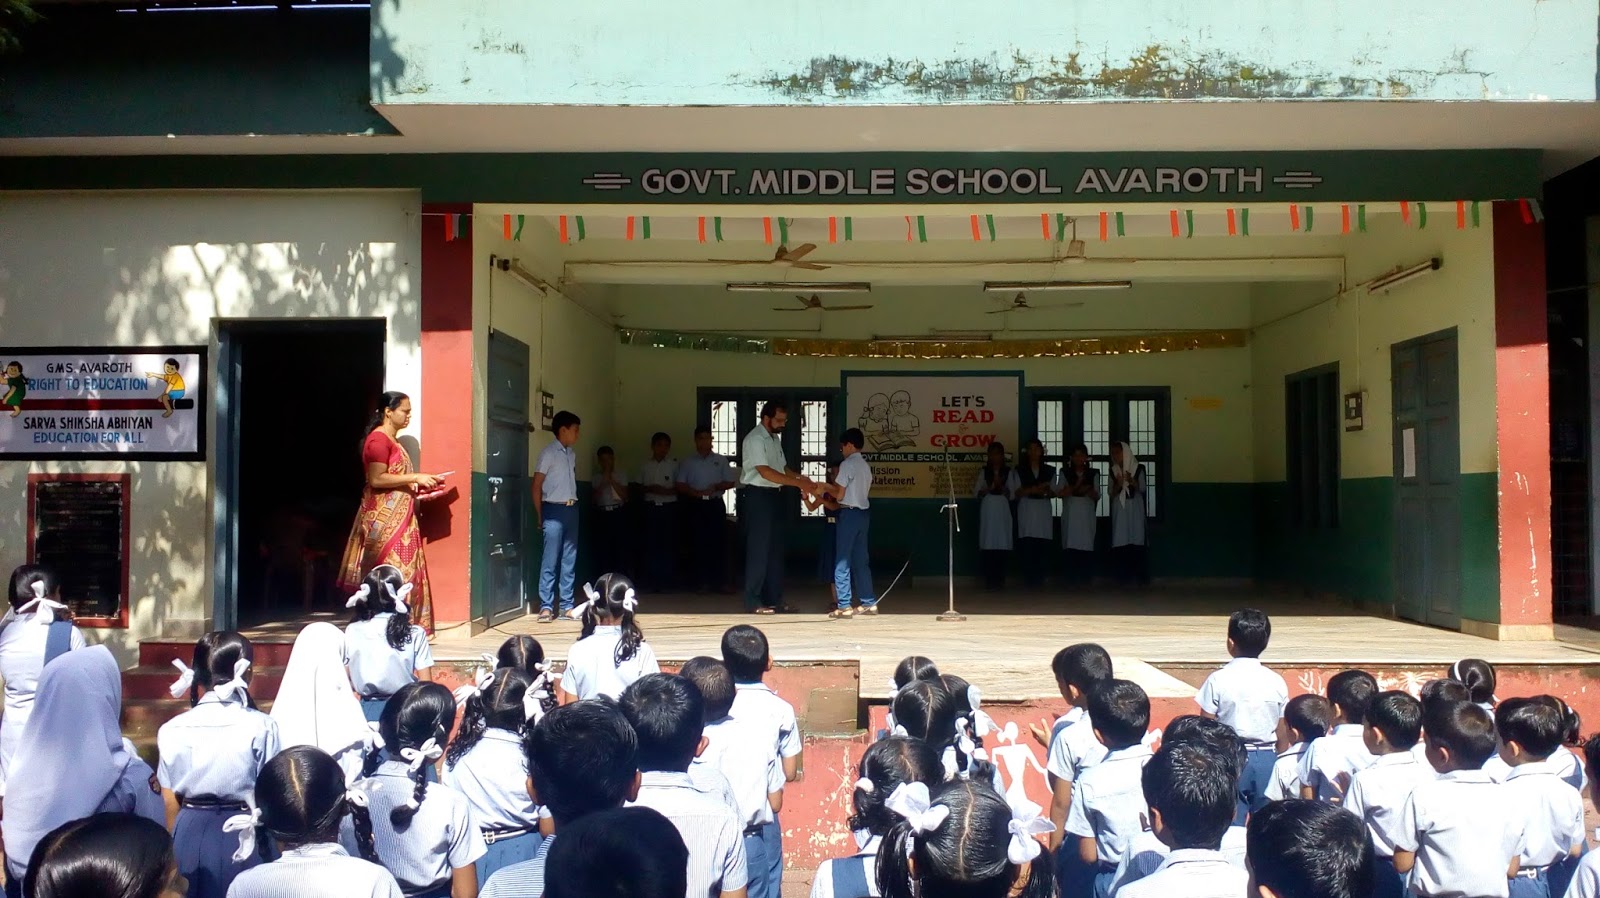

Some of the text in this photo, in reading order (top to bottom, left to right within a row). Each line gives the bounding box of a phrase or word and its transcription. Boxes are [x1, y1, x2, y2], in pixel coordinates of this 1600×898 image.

[640, 167, 1264, 195] GOVT. MIDDLE SCHOOL AVAROTH
[79, 362, 133, 373] AVAROTH
[28, 378, 148, 391] RIGHT TO EDUCATION
[941, 395, 986, 408] LET'S
[23, 416, 153, 430] SARVA SHIKSHA ABHIYAN
[932, 410, 995, 424] READ
[33, 432, 144, 444] EDUCATION FOR ALL
[930, 434, 997, 448] GROW
[861, 453, 879, 461] OVT
[880, 453, 915, 461] MIDDLE
[916, 453, 958, 461] SCHOOL
